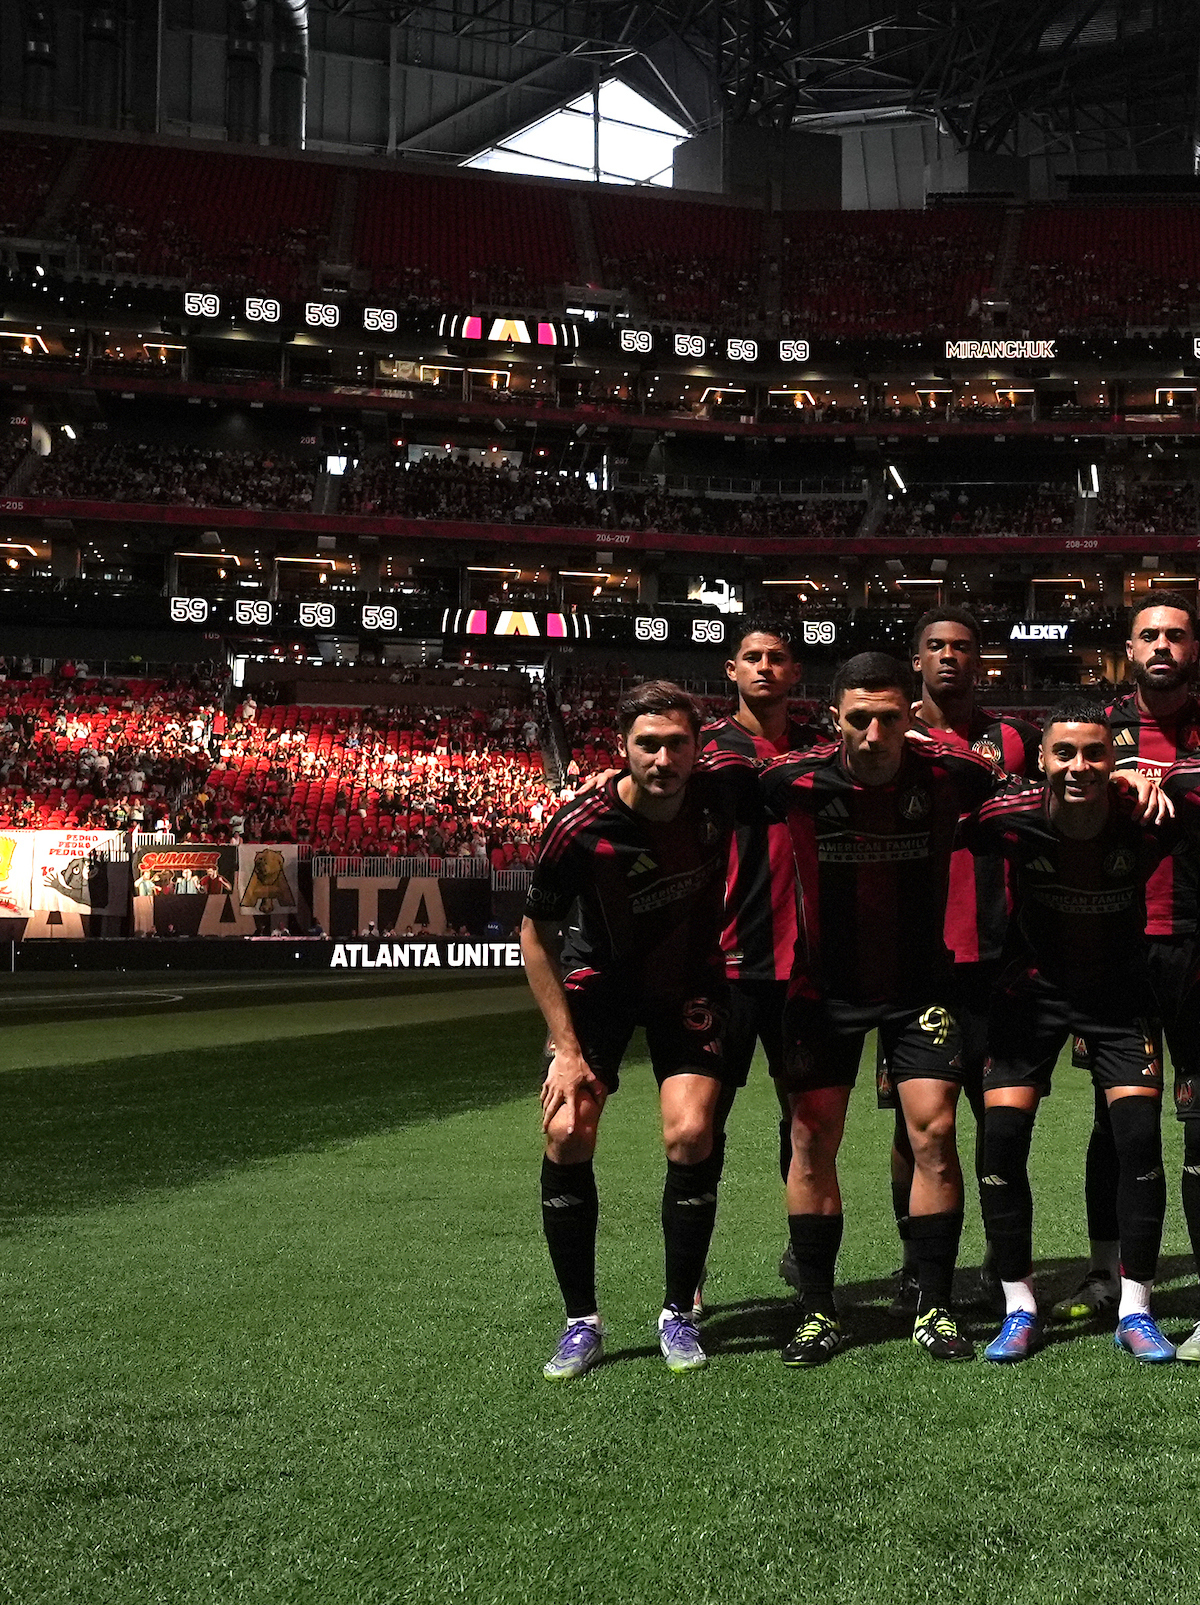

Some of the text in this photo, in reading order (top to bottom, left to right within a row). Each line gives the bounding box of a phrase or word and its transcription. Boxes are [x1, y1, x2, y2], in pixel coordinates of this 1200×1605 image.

[185, 293, 397, 331] 59 59 59 59
[621, 330, 809, 361] 59 59 59 59
[945, 340, 1055, 359] MIRANCHUK
[0, 501, 24, 510] -205
[596, 534, 631, 543] 206-207
[171, 597, 398, 630] 59 59 59 59
[635, 617, 835, 644] 59 59 59
[1010, 625, 1068, 640] ALEXEY
[49, 848, 84, 856] PEDRO
[818, 836, 930, 852] AMERICAN FAMILY
[138, 852, 221, 870] SUMMER
[632, 879, 693, 906] AMERICAN
[1092, 890, 1134, 904] FAMILY
[330, 944, 525, 968] ATLANTA UNITE
[918, 1006, 948, 1045] 9
